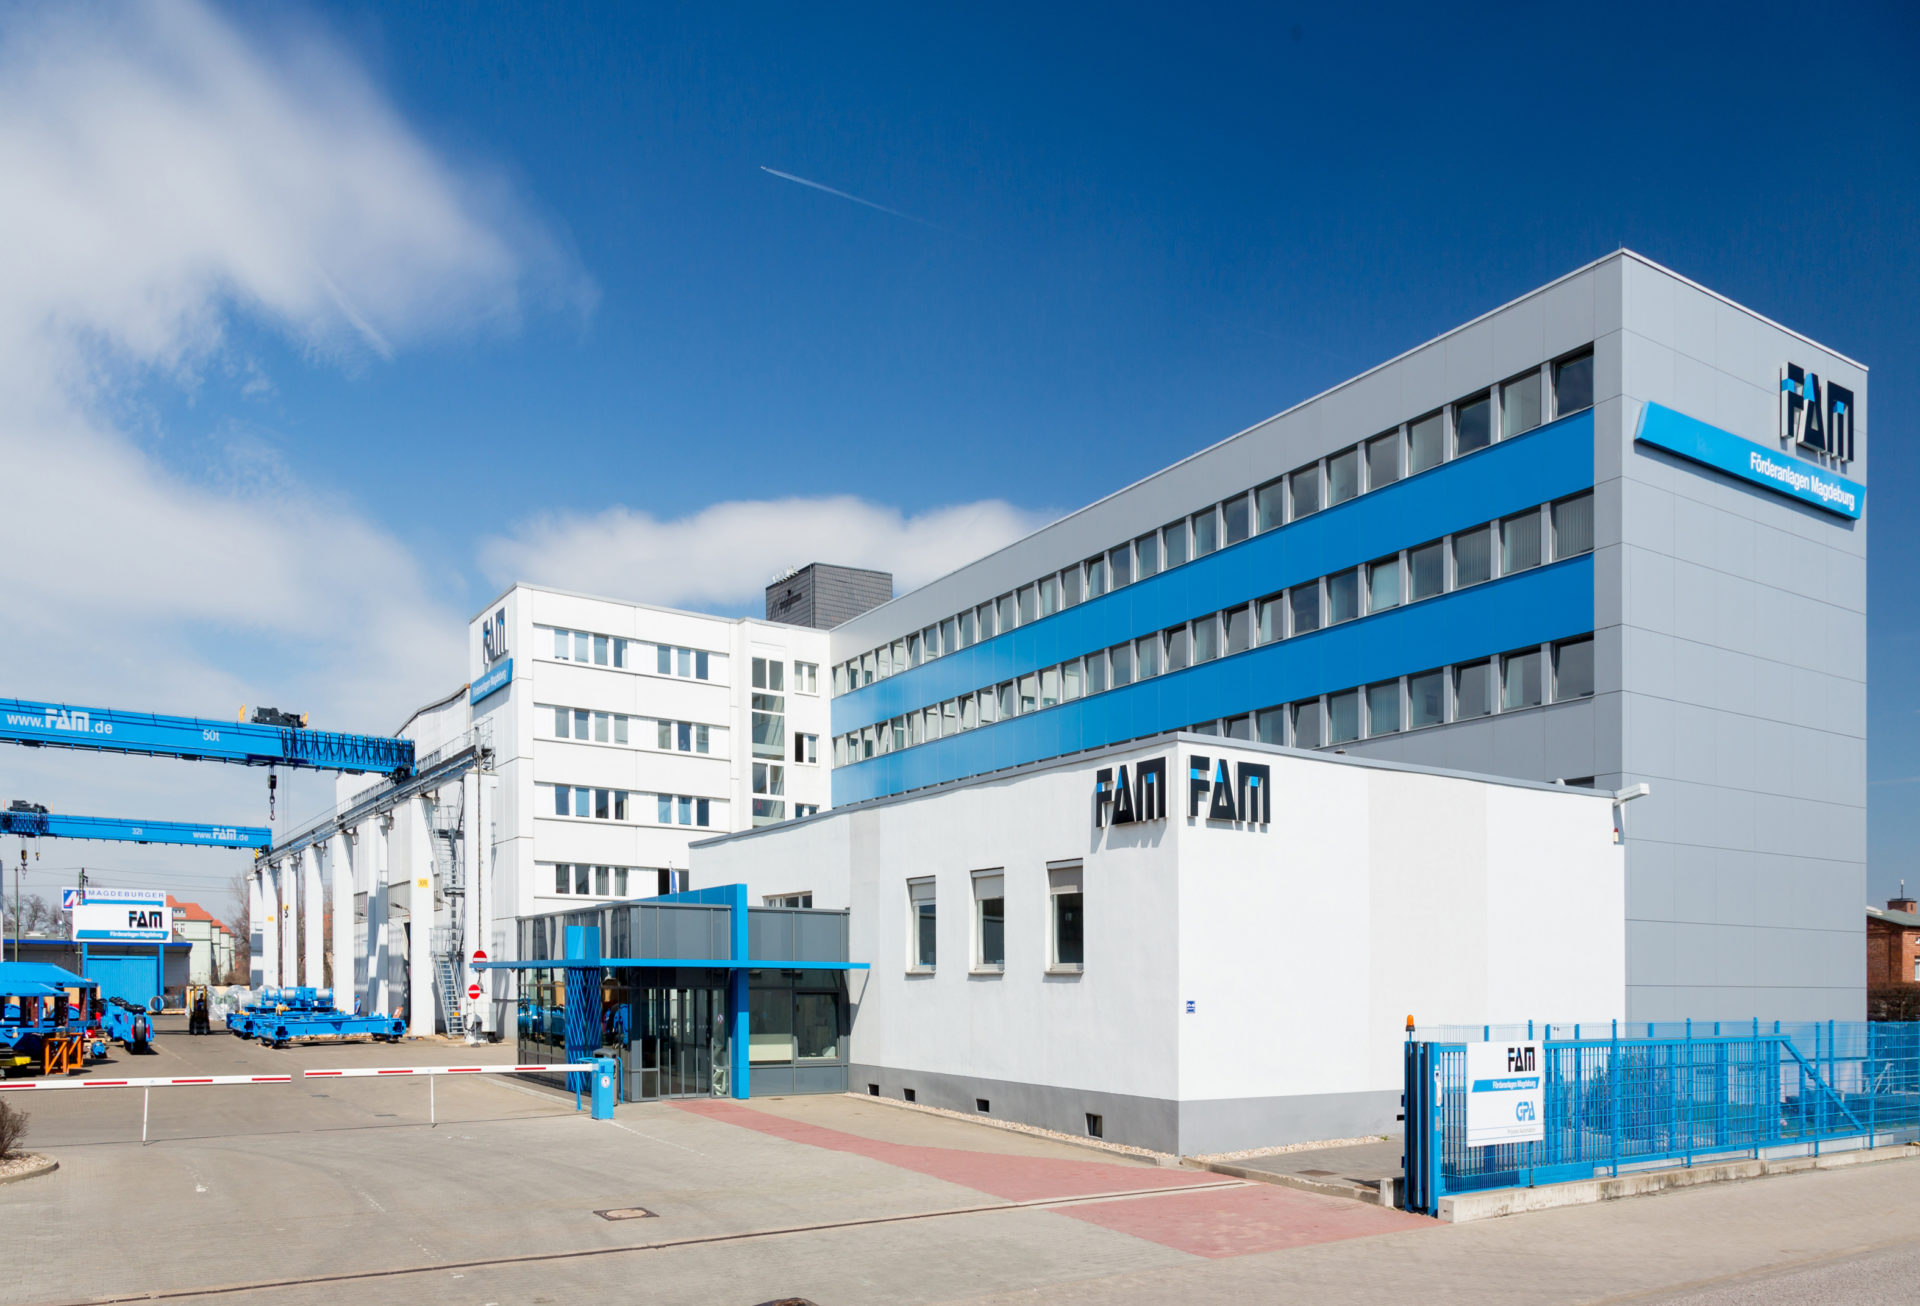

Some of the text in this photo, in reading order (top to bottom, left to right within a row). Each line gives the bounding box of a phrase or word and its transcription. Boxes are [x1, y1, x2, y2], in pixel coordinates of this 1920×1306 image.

[1780, 362, 1854, 463] FAM
[1750, 451, 1855, 512] Förderanlagen Magdeburg
[482, 606, 508, 665] FAM
[202, 729, 220, 742] 50t
[1096, 756, 1168, 828] FAM
[1187, 755, 1271, 824] FAM
[88, 890, 165, 898] MAGDEBURGER
[128, 910, 163, 928] FAM
[1508, 1047, 1535, 1072] FAM
